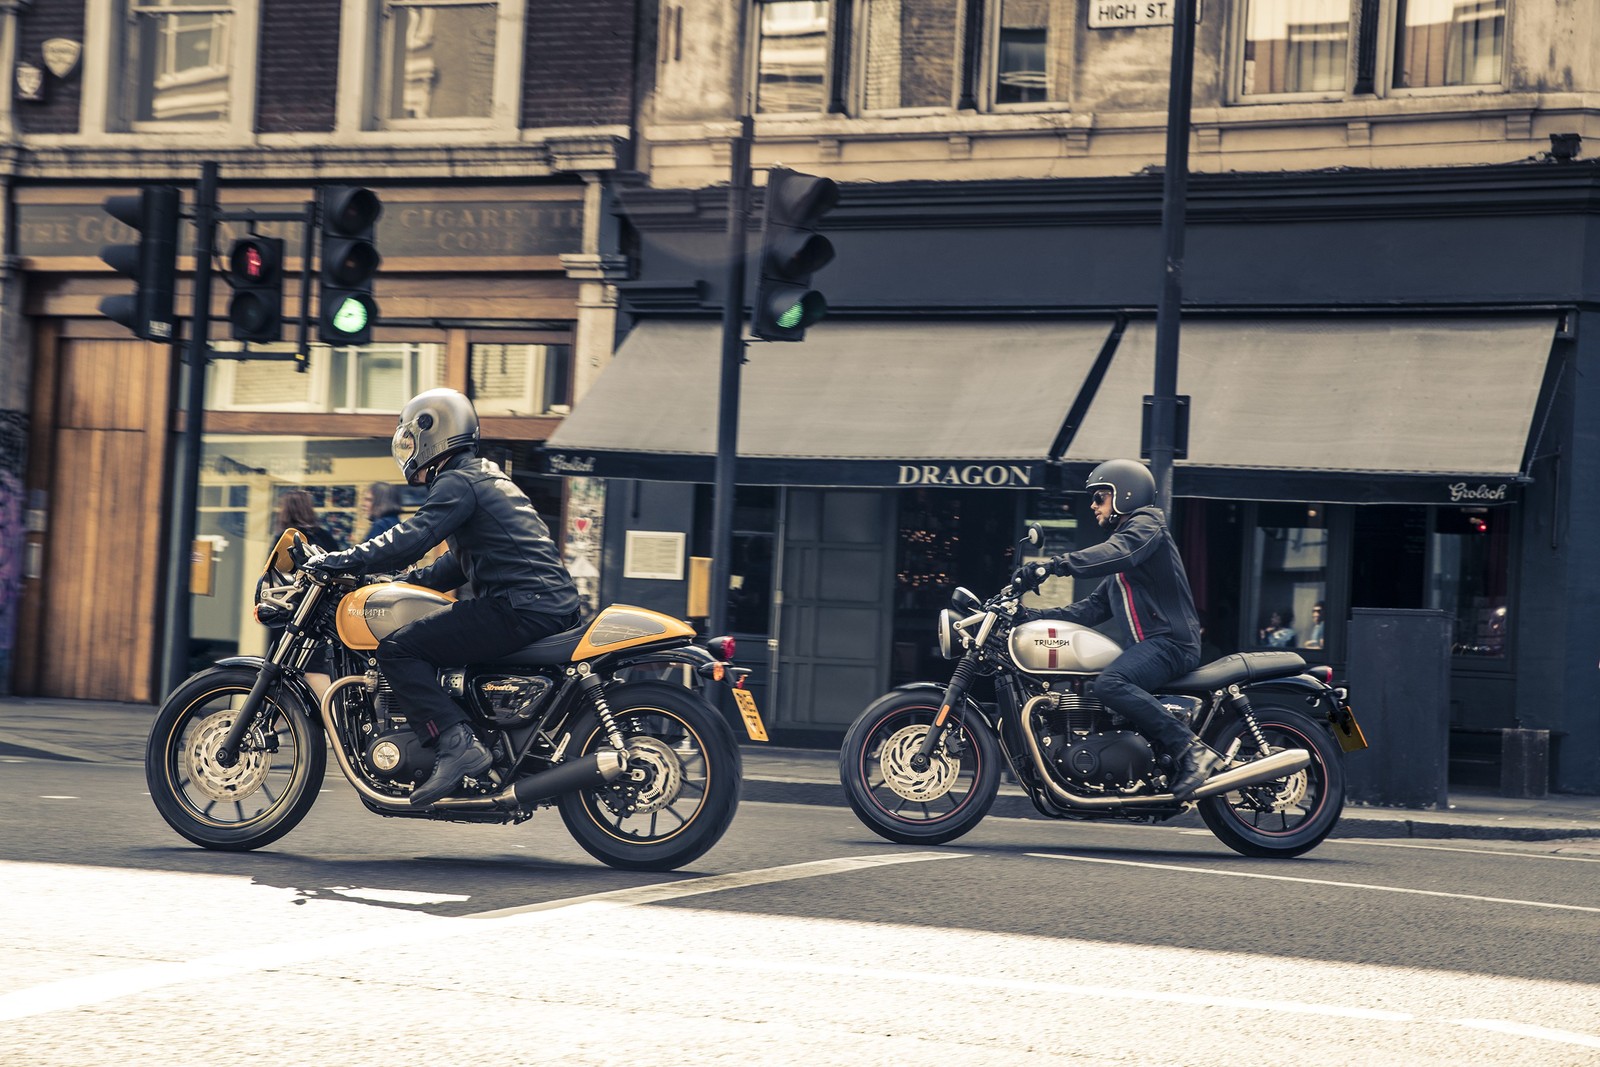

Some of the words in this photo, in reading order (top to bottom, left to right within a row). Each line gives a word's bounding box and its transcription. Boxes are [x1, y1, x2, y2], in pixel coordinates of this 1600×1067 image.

[1098, 4, 1137, 21] HIGH
[897, 465, 1032, 486] DRAGON
[1448, 482, 1507, 501] Grolsch
[347, 607, 385, 617] TRIUMPH
[1034, 639, 1070, 647] TRIUMPH
